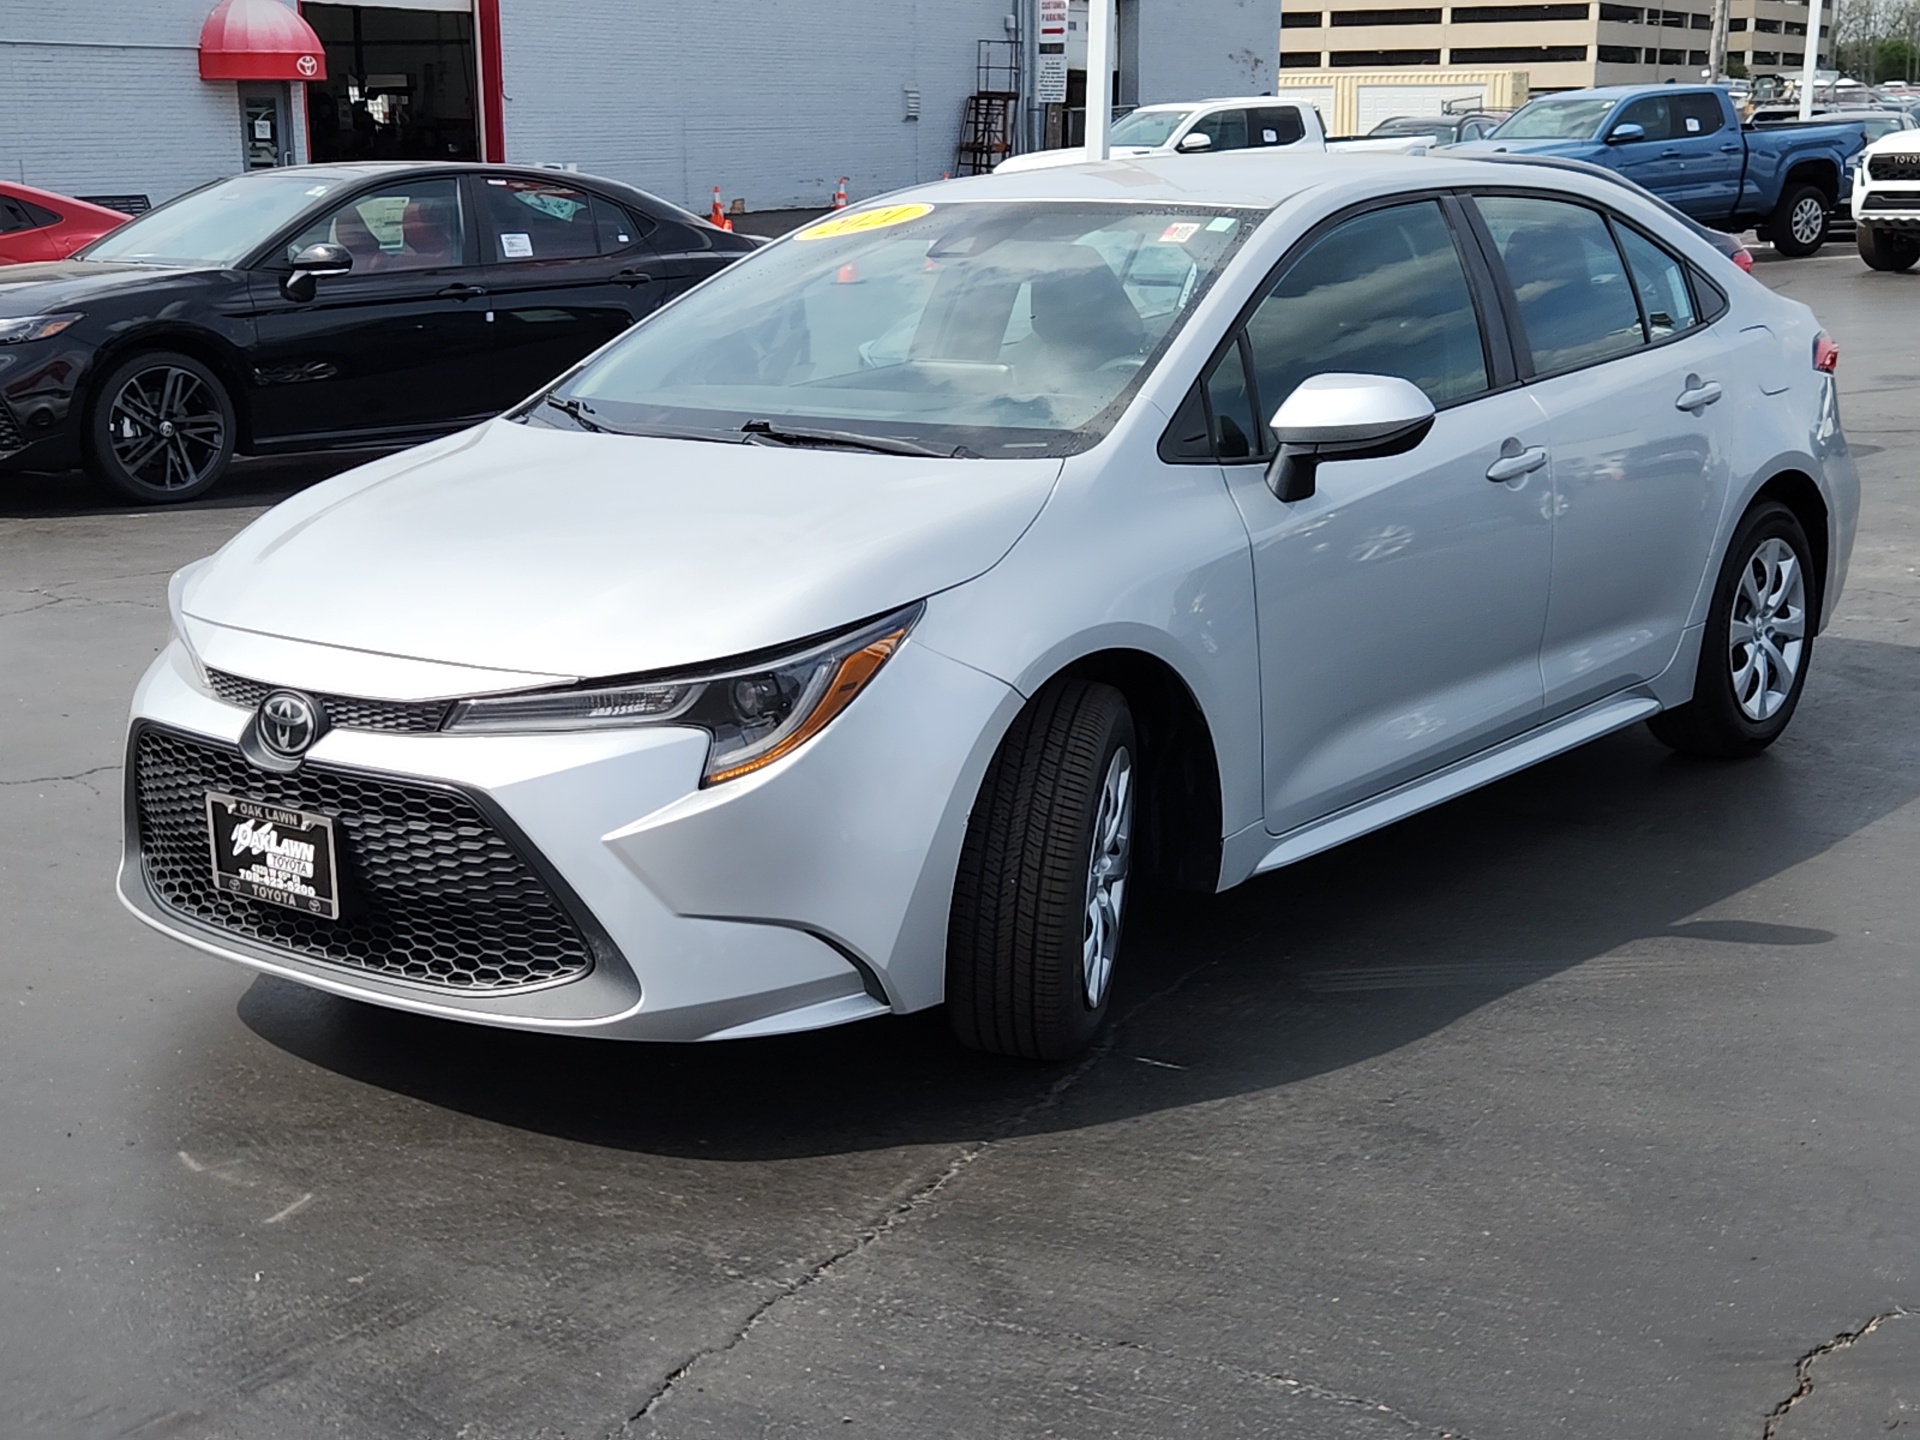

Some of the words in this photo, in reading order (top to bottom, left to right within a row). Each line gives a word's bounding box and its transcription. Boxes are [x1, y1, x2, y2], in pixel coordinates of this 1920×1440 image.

[1041, 13, 1066, 22] PARKING
[1894, 155, 1920, 164] TOYO
[240, 802, 263, 818] OAK
[265, 808, 298, 826] LAWN
[272, 855, 308, 875] TOYOTA
[251, 884, 297, 907] TOYOTA
